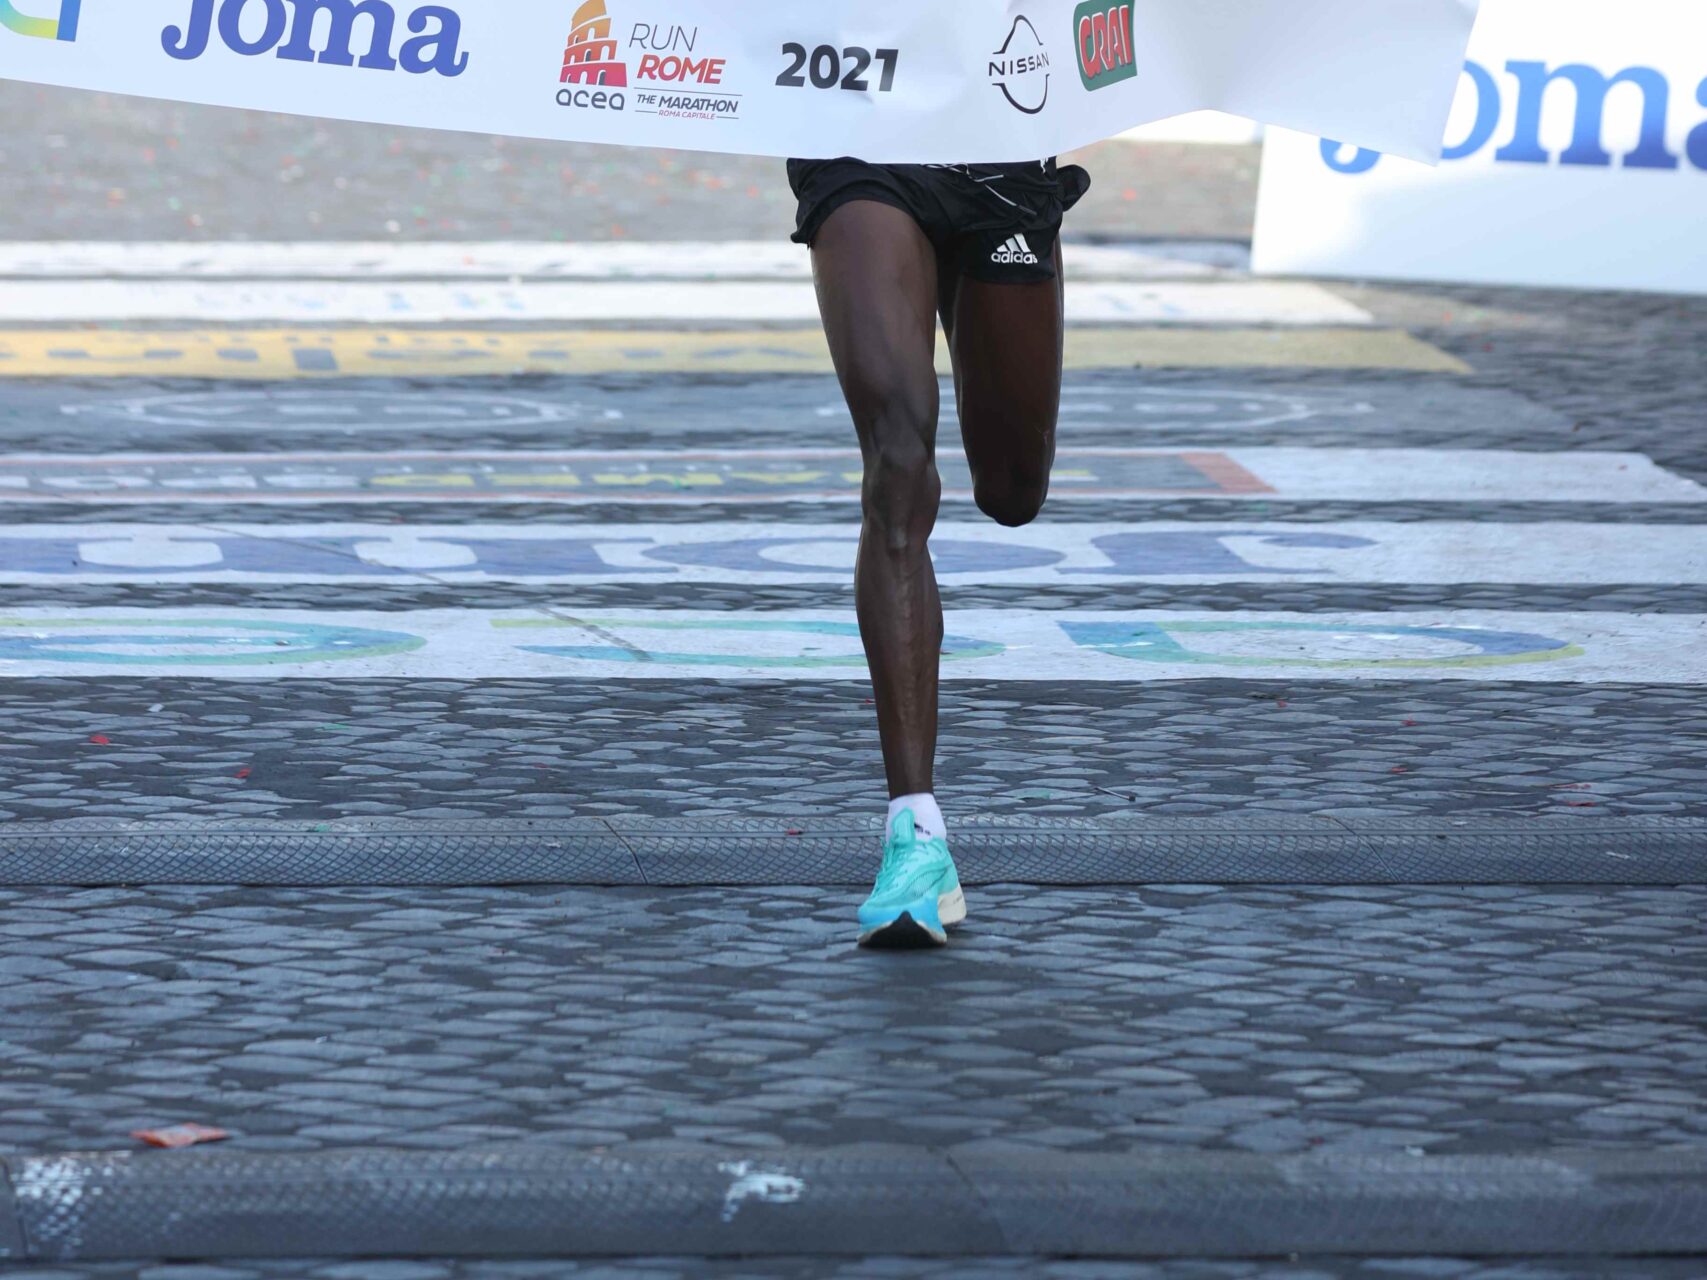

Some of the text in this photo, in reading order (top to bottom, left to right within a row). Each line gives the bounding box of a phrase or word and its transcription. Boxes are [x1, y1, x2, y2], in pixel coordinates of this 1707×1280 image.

[628, 22, 698, 52] RUN
[1079, 4, 1133, 79] CRAI
[636, 54, 726, 85] ROME
[775, 42, 899, 92] 2021
[988, 51, 1050, 77] NISSAN
[555, 88, 625, 111] acea
[637, 94, 739, 113] THE MARATHON
[658, 109, 716, 121] ROMA CAPITALE
[991, 250, 1038, 265] adidas
